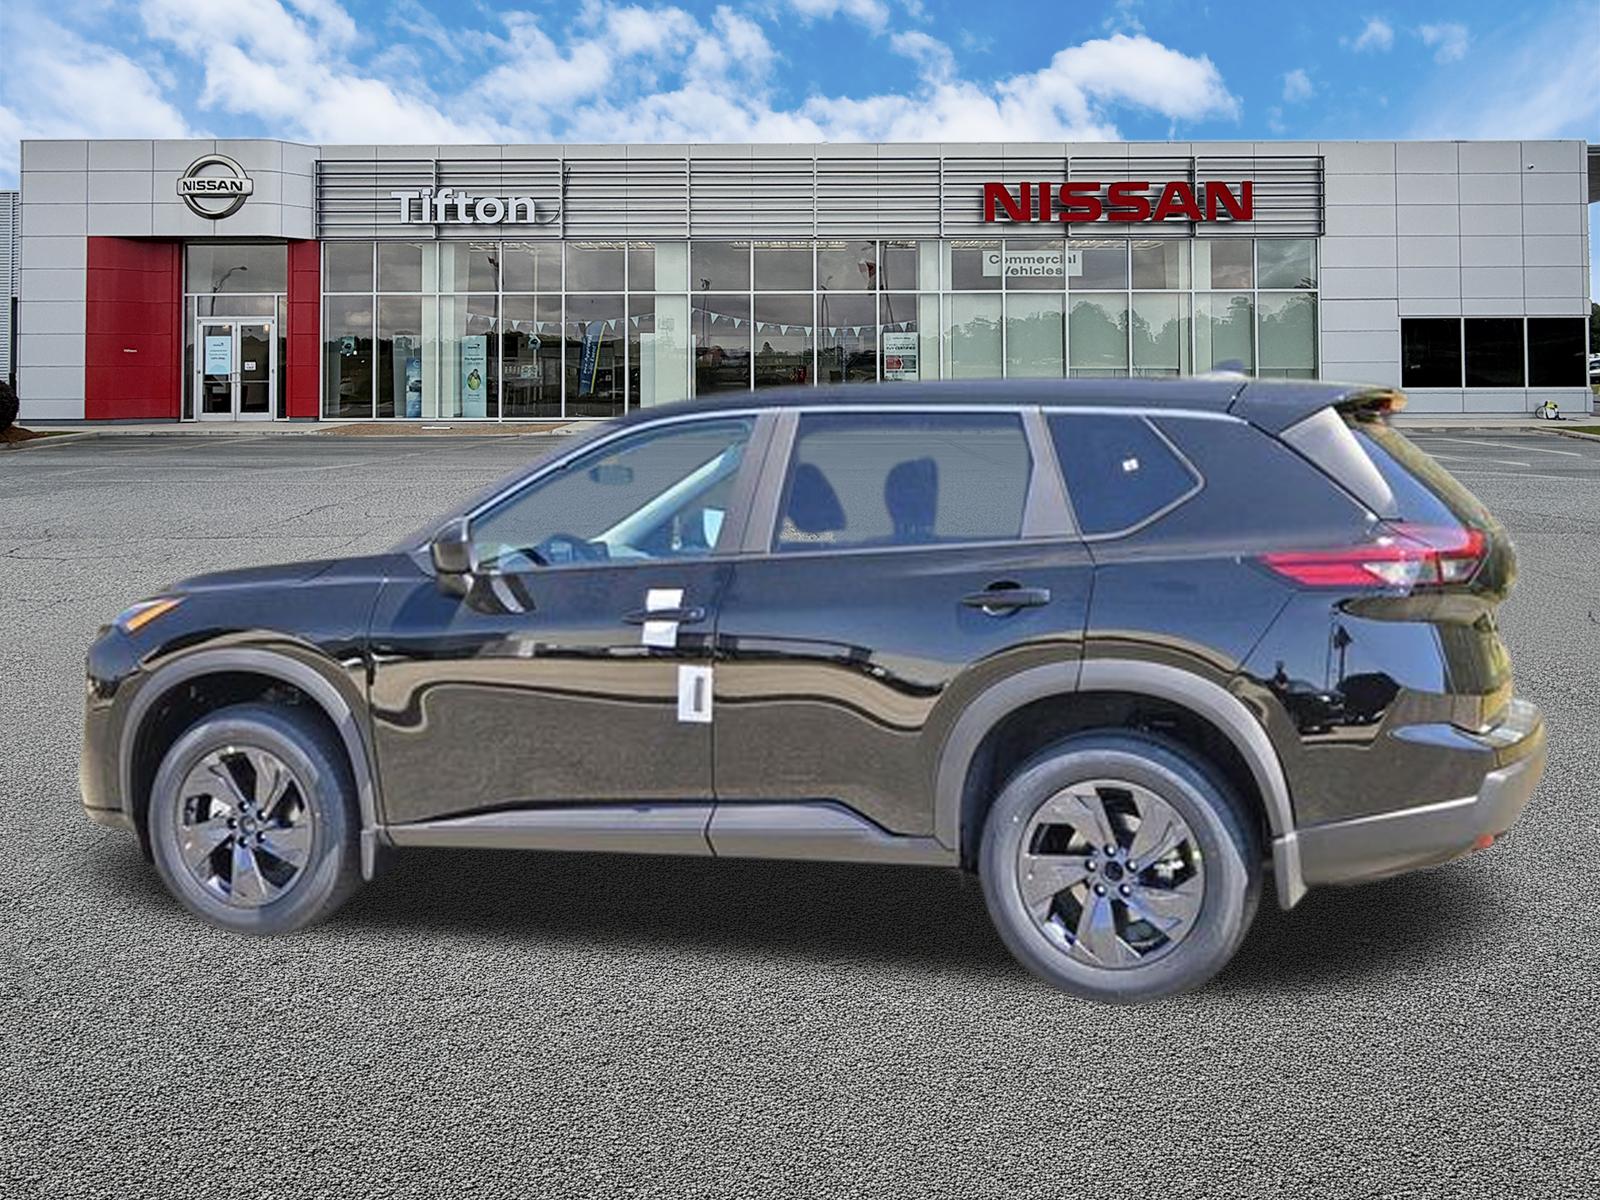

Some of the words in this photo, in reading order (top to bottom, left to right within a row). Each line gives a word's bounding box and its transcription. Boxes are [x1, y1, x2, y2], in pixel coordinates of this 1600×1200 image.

[183, 181, 242, 191] NISSAN
[984, 181, 1253, 221] NISSAN
[391, 188, 535, 223] Tifton
